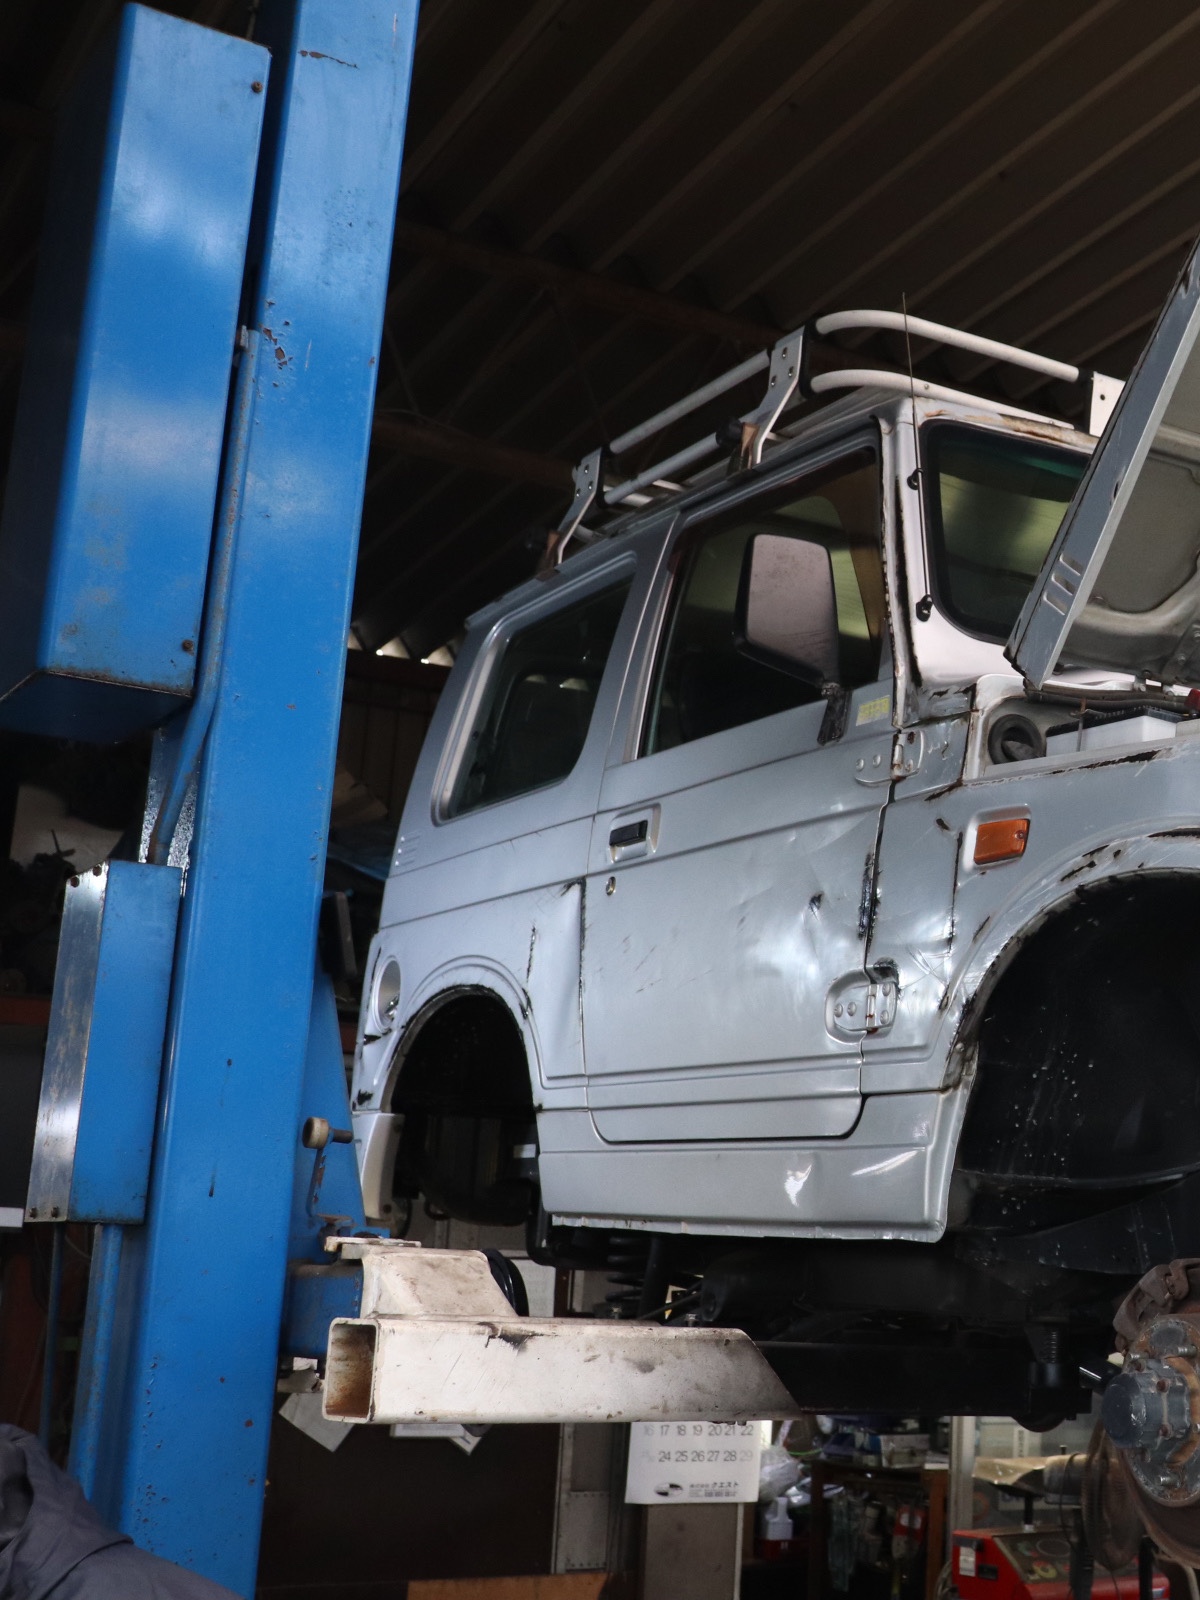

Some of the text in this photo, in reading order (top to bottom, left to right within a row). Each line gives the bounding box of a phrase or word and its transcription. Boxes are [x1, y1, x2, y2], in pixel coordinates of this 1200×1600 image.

[660, 1424, 670, 1436] 17
[677, 1424, 687, 1436] 18
[693, 1424, 703, 1436] 19
[708, 1424, 722, 1436] 20
[724, 1424, 736, 1436] 21
[741, 1424, 754, 1436] 22
[658, 1450, 671, 1463] 24
[675, 1450, 688, 1462] 25
[691, 1450, 705, 1462] 26
[707, 1450, 720, 1462] 27
[723, 1450, 737, 1462] 28
